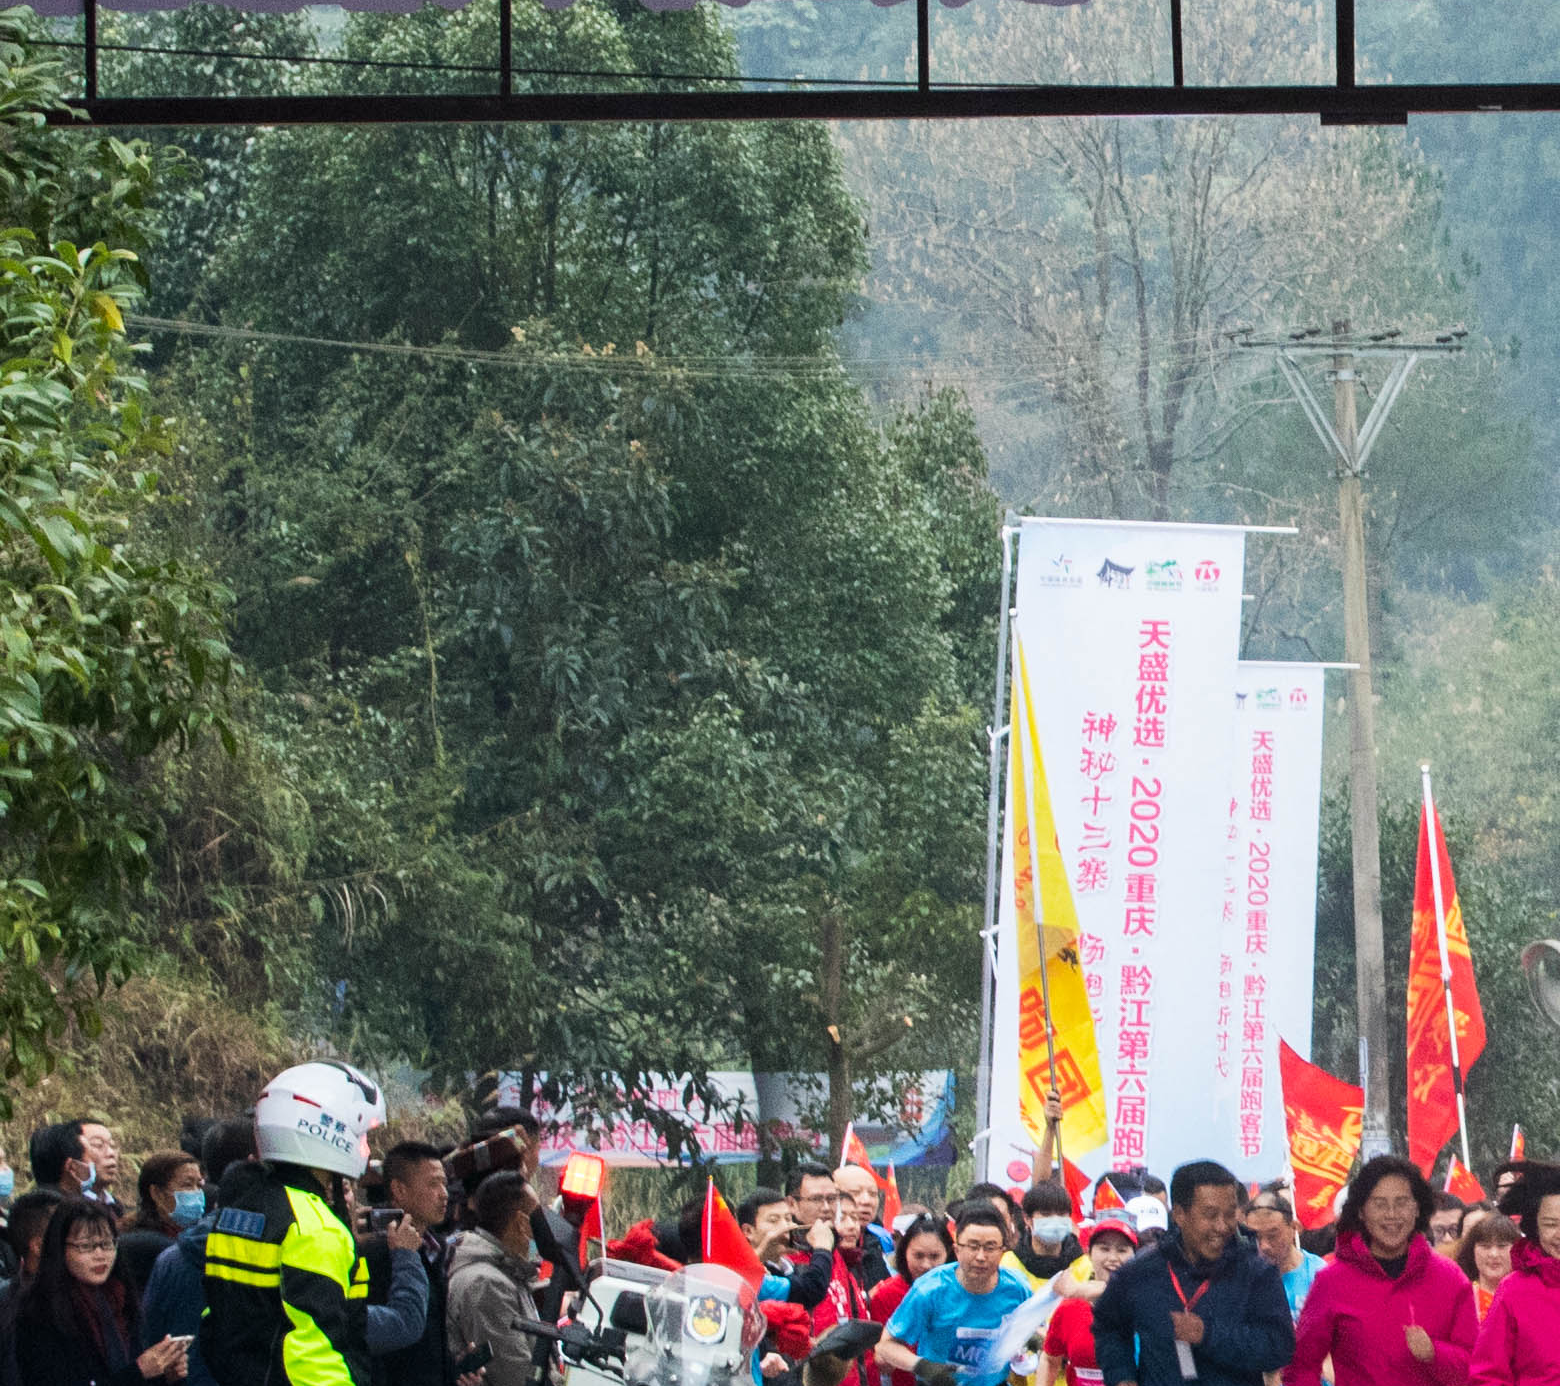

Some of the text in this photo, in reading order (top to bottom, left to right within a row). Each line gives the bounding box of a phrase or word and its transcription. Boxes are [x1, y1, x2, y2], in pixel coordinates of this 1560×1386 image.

[1110, 619, 1174, 1174] 天盛优选·2020重庆·黔江第六届跑
[298, 1119, 353, 1154] POLICE
